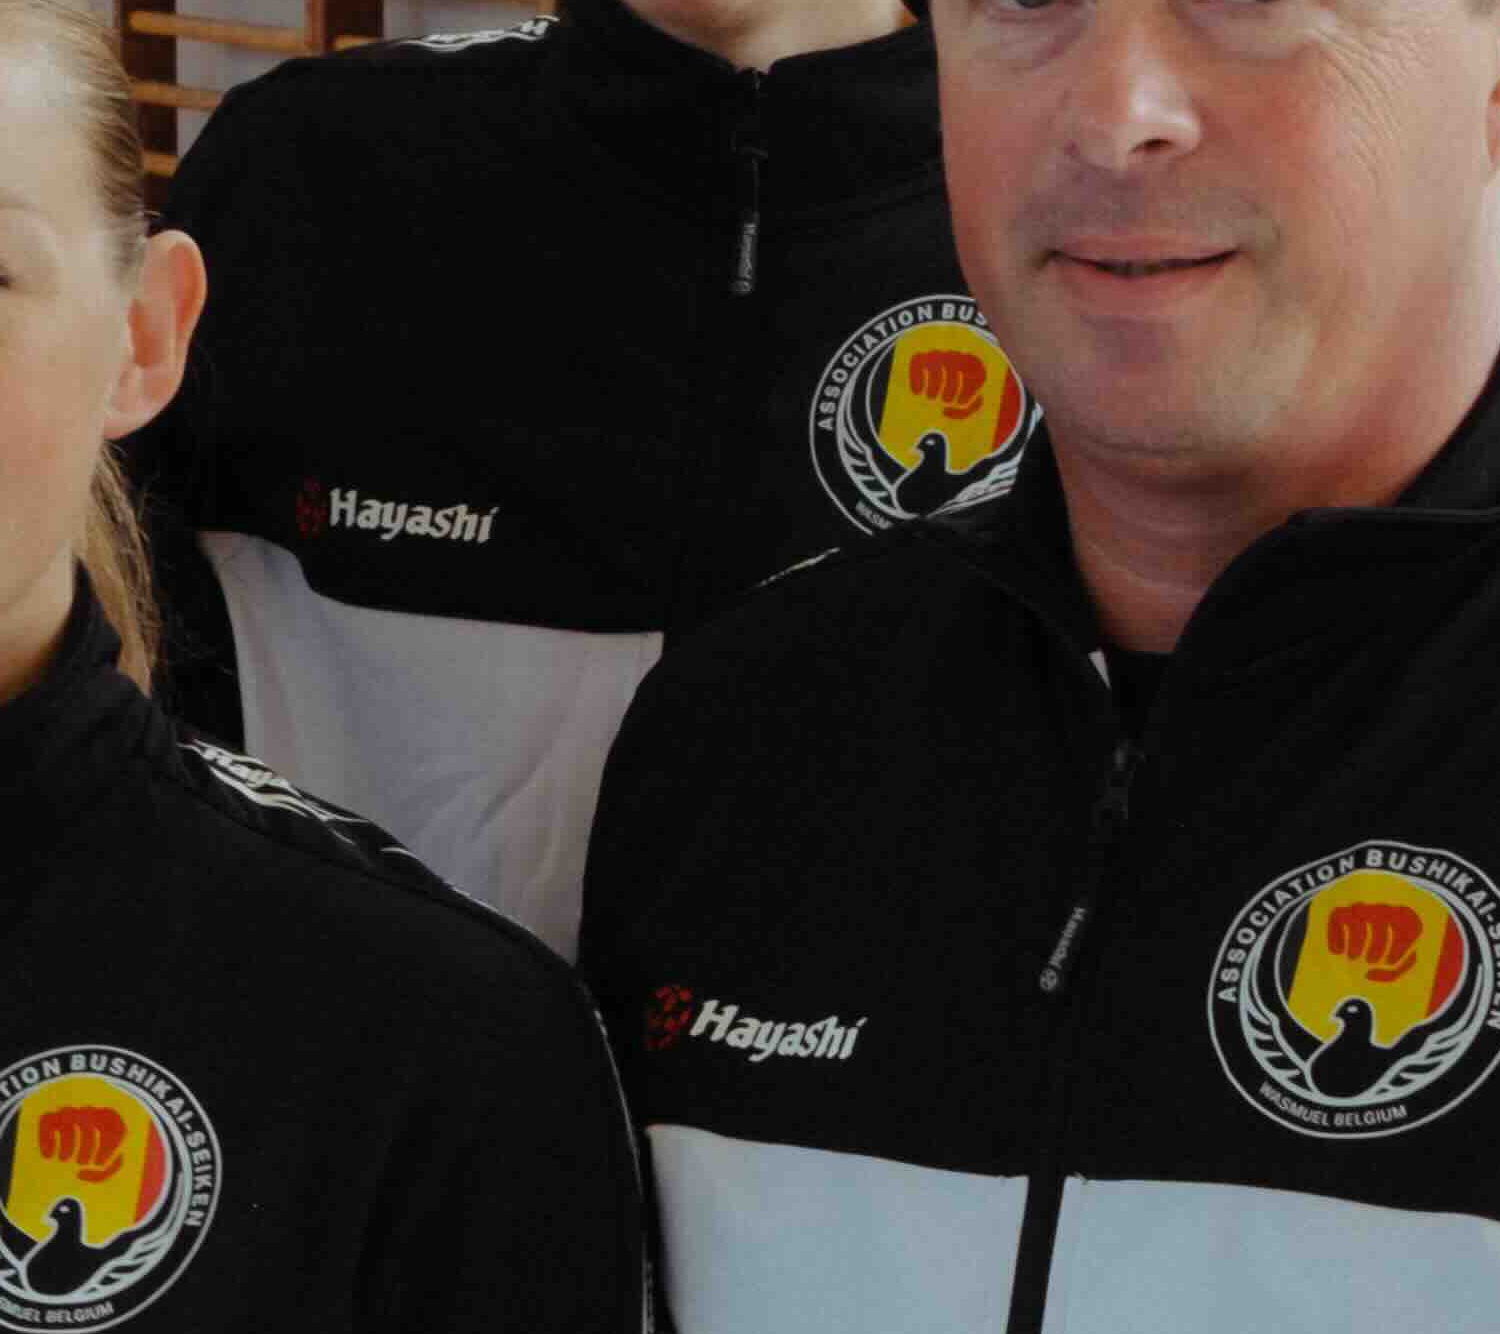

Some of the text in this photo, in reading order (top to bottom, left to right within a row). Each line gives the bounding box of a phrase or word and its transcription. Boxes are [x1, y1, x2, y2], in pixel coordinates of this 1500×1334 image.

[817, 304, 933, 431] ASSOCIATION
[329, 487, 499, 543] Hayashi
[1217, 855, 1356, 1003] ASSOCIATION
[689, 999, 867, 1062] Hayashi
[1257, 1079, 1408, 1128] WASMUEL BELGIUM
[70, 1053, 216, 1227] BUSHIKAI-SEIKEN
[44, 1302, 115, 1324] BELGIUM
